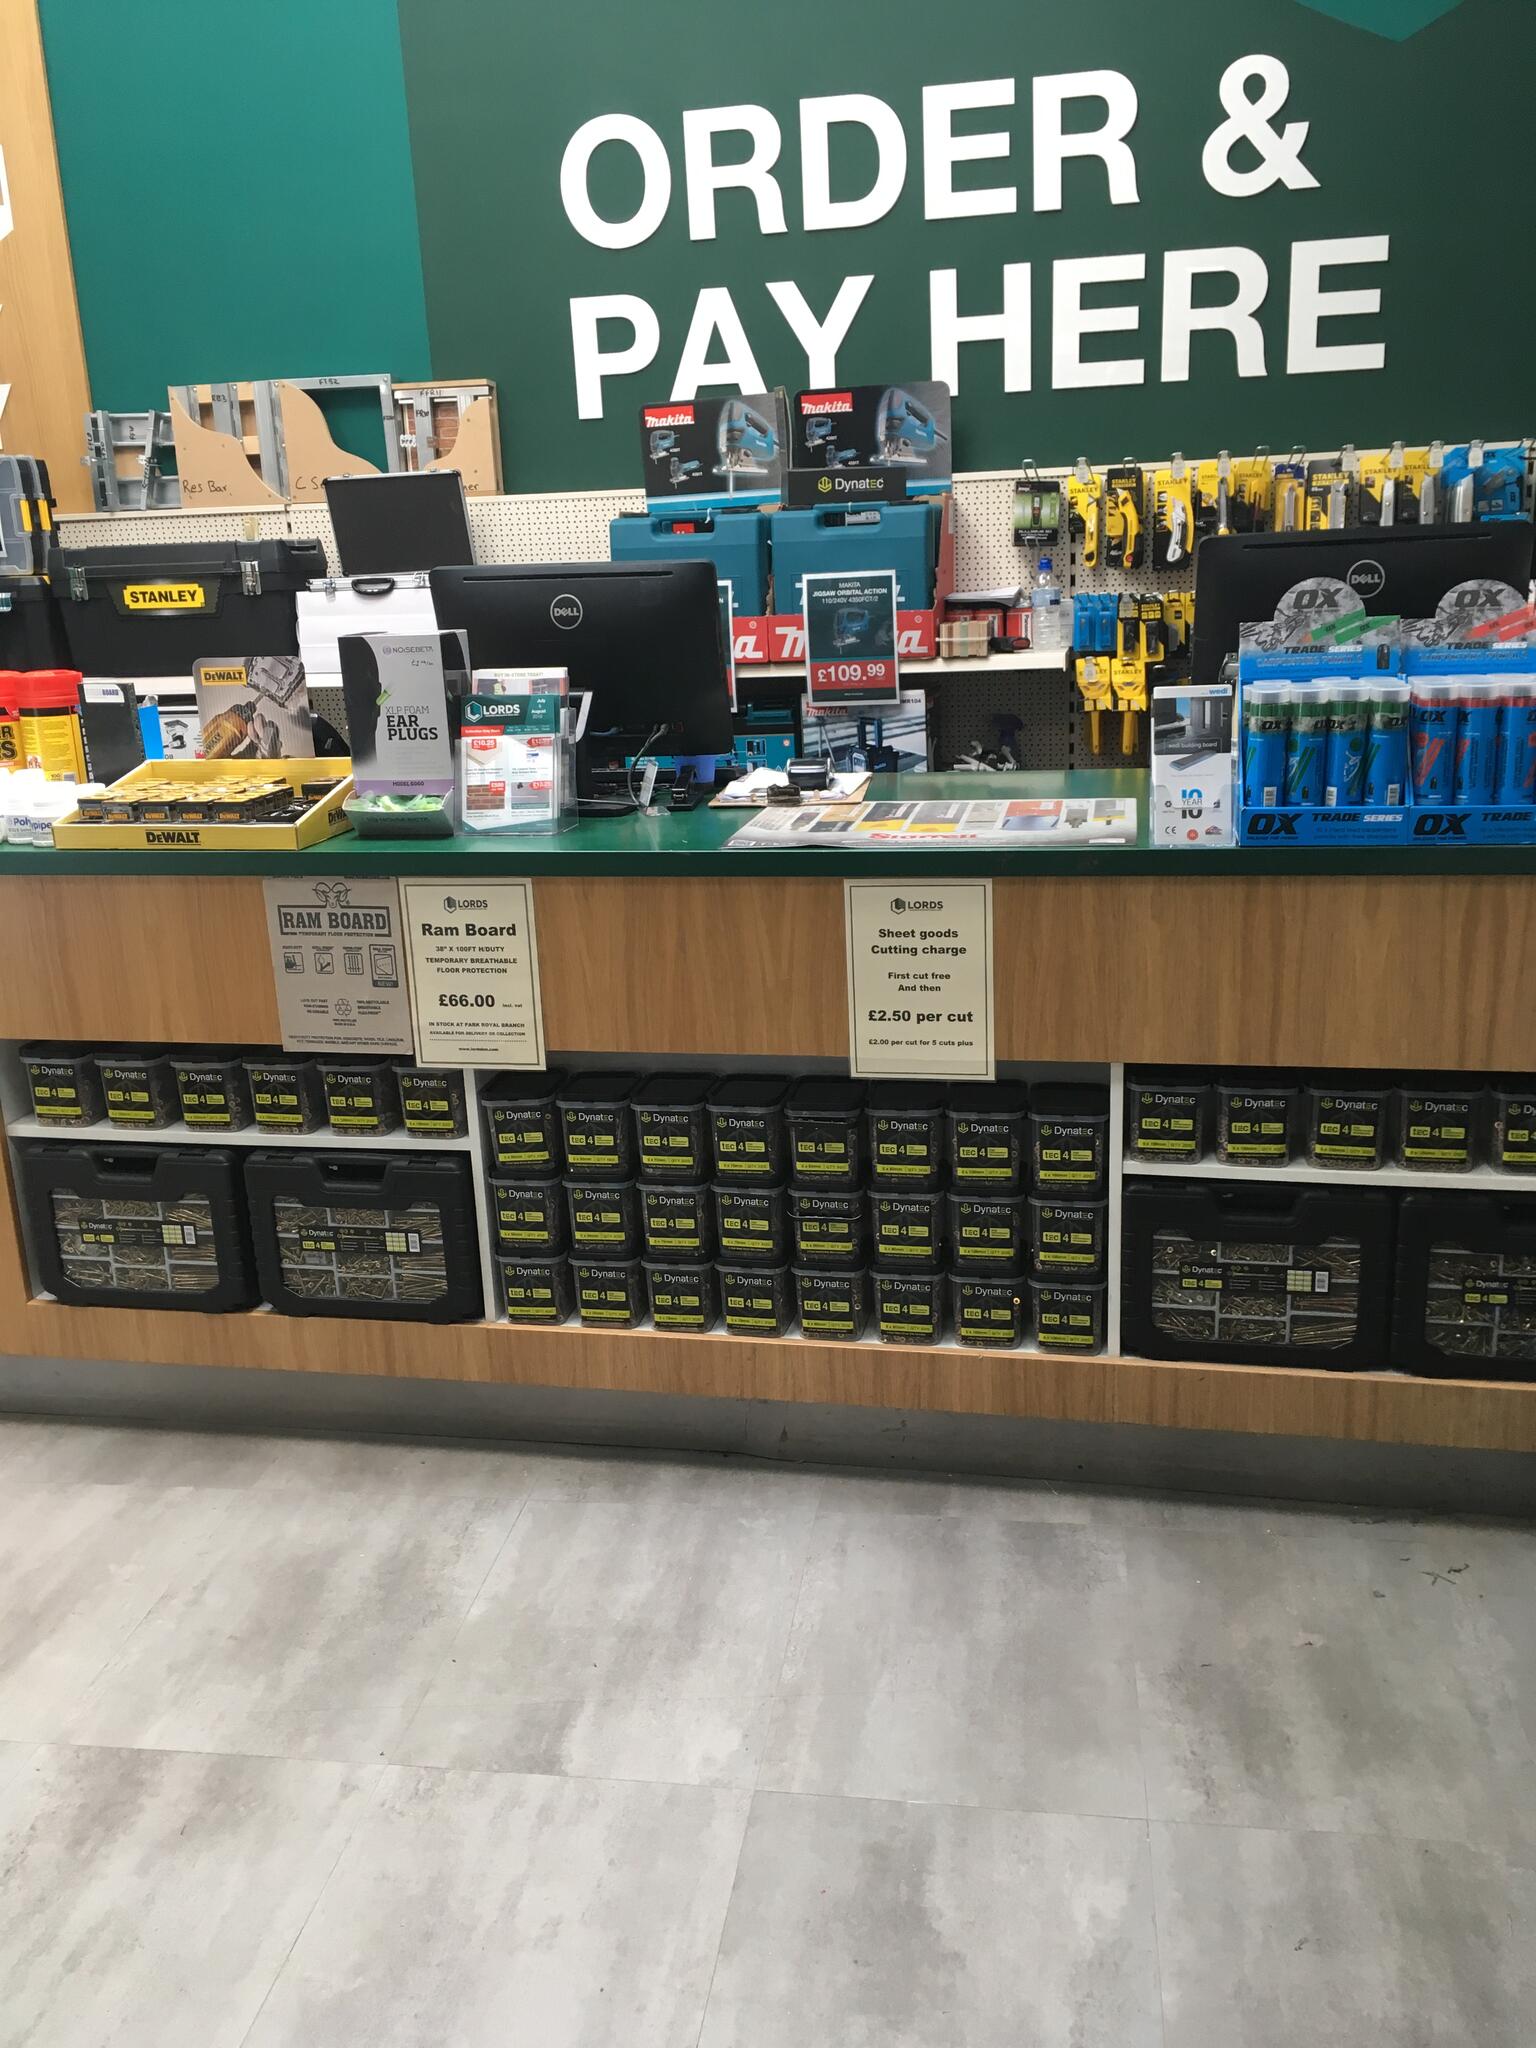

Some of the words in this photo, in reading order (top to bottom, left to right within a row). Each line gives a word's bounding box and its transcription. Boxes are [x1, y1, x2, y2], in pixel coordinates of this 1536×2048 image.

[560, 69, 1140, 249] ORDER
[1201, 54, 1320, 198] &
[569, 275, 874, 421] PAY
[929, 235, 1390, 395] HERE
[802, 400, 853, 415] makita
[1351, 575, 1381, 584] DELL
[130, 589, 198, 604] STANLEY
[1293, 588, 1344, 609] OX
[1455, 588, 1506, 607] OX
[554, 607, 579, 617] DELL
[1284, 646, 1325, 654] TRADE
[817, 663, 886, 682] £109.99
[404, 705, 429, 714] FOAM
[483, 704, 520, 715] LORDS
[387, 715, 419, 727] EAR
[388, 727, 438, 741] PLUGS
[1312, 813, 1361, 822] TRADE
[1363, 814, 1403, 822] SERIES
[1480, 812, 1533, 821] TRADE
[1247, 813, 1304, 835] OX
[1413, 813, 1472, 835] OX
[458, 900, 488, 908] LORDS
[908, 901, 944, 910] LORDS
[282, 912, 322, 929] RAM
[328, 912, 387, 930] BOARD
[421, 923, 459, 936] Ram
[465, 923, 517, 936] Board
[878, 928, 916, 938] Sheet
[919, 928, 959, 940] goods
[871, 945, 918, 956] Cutting
[921, 945, 967, 956] charge
[887, 972, 910, 980] First
[912, 972, 929, 980] cut
[931, 972, 951, 980] free
[898, 984, 917, 992] And
[919, 984, 941, 992] then
[438, 994, 495, 1008] £66.00
[868, 1010, 911, 1022] £2.50
[916, 1012, 942, 1024] per
[947, 1011, 974, 1023] cut
